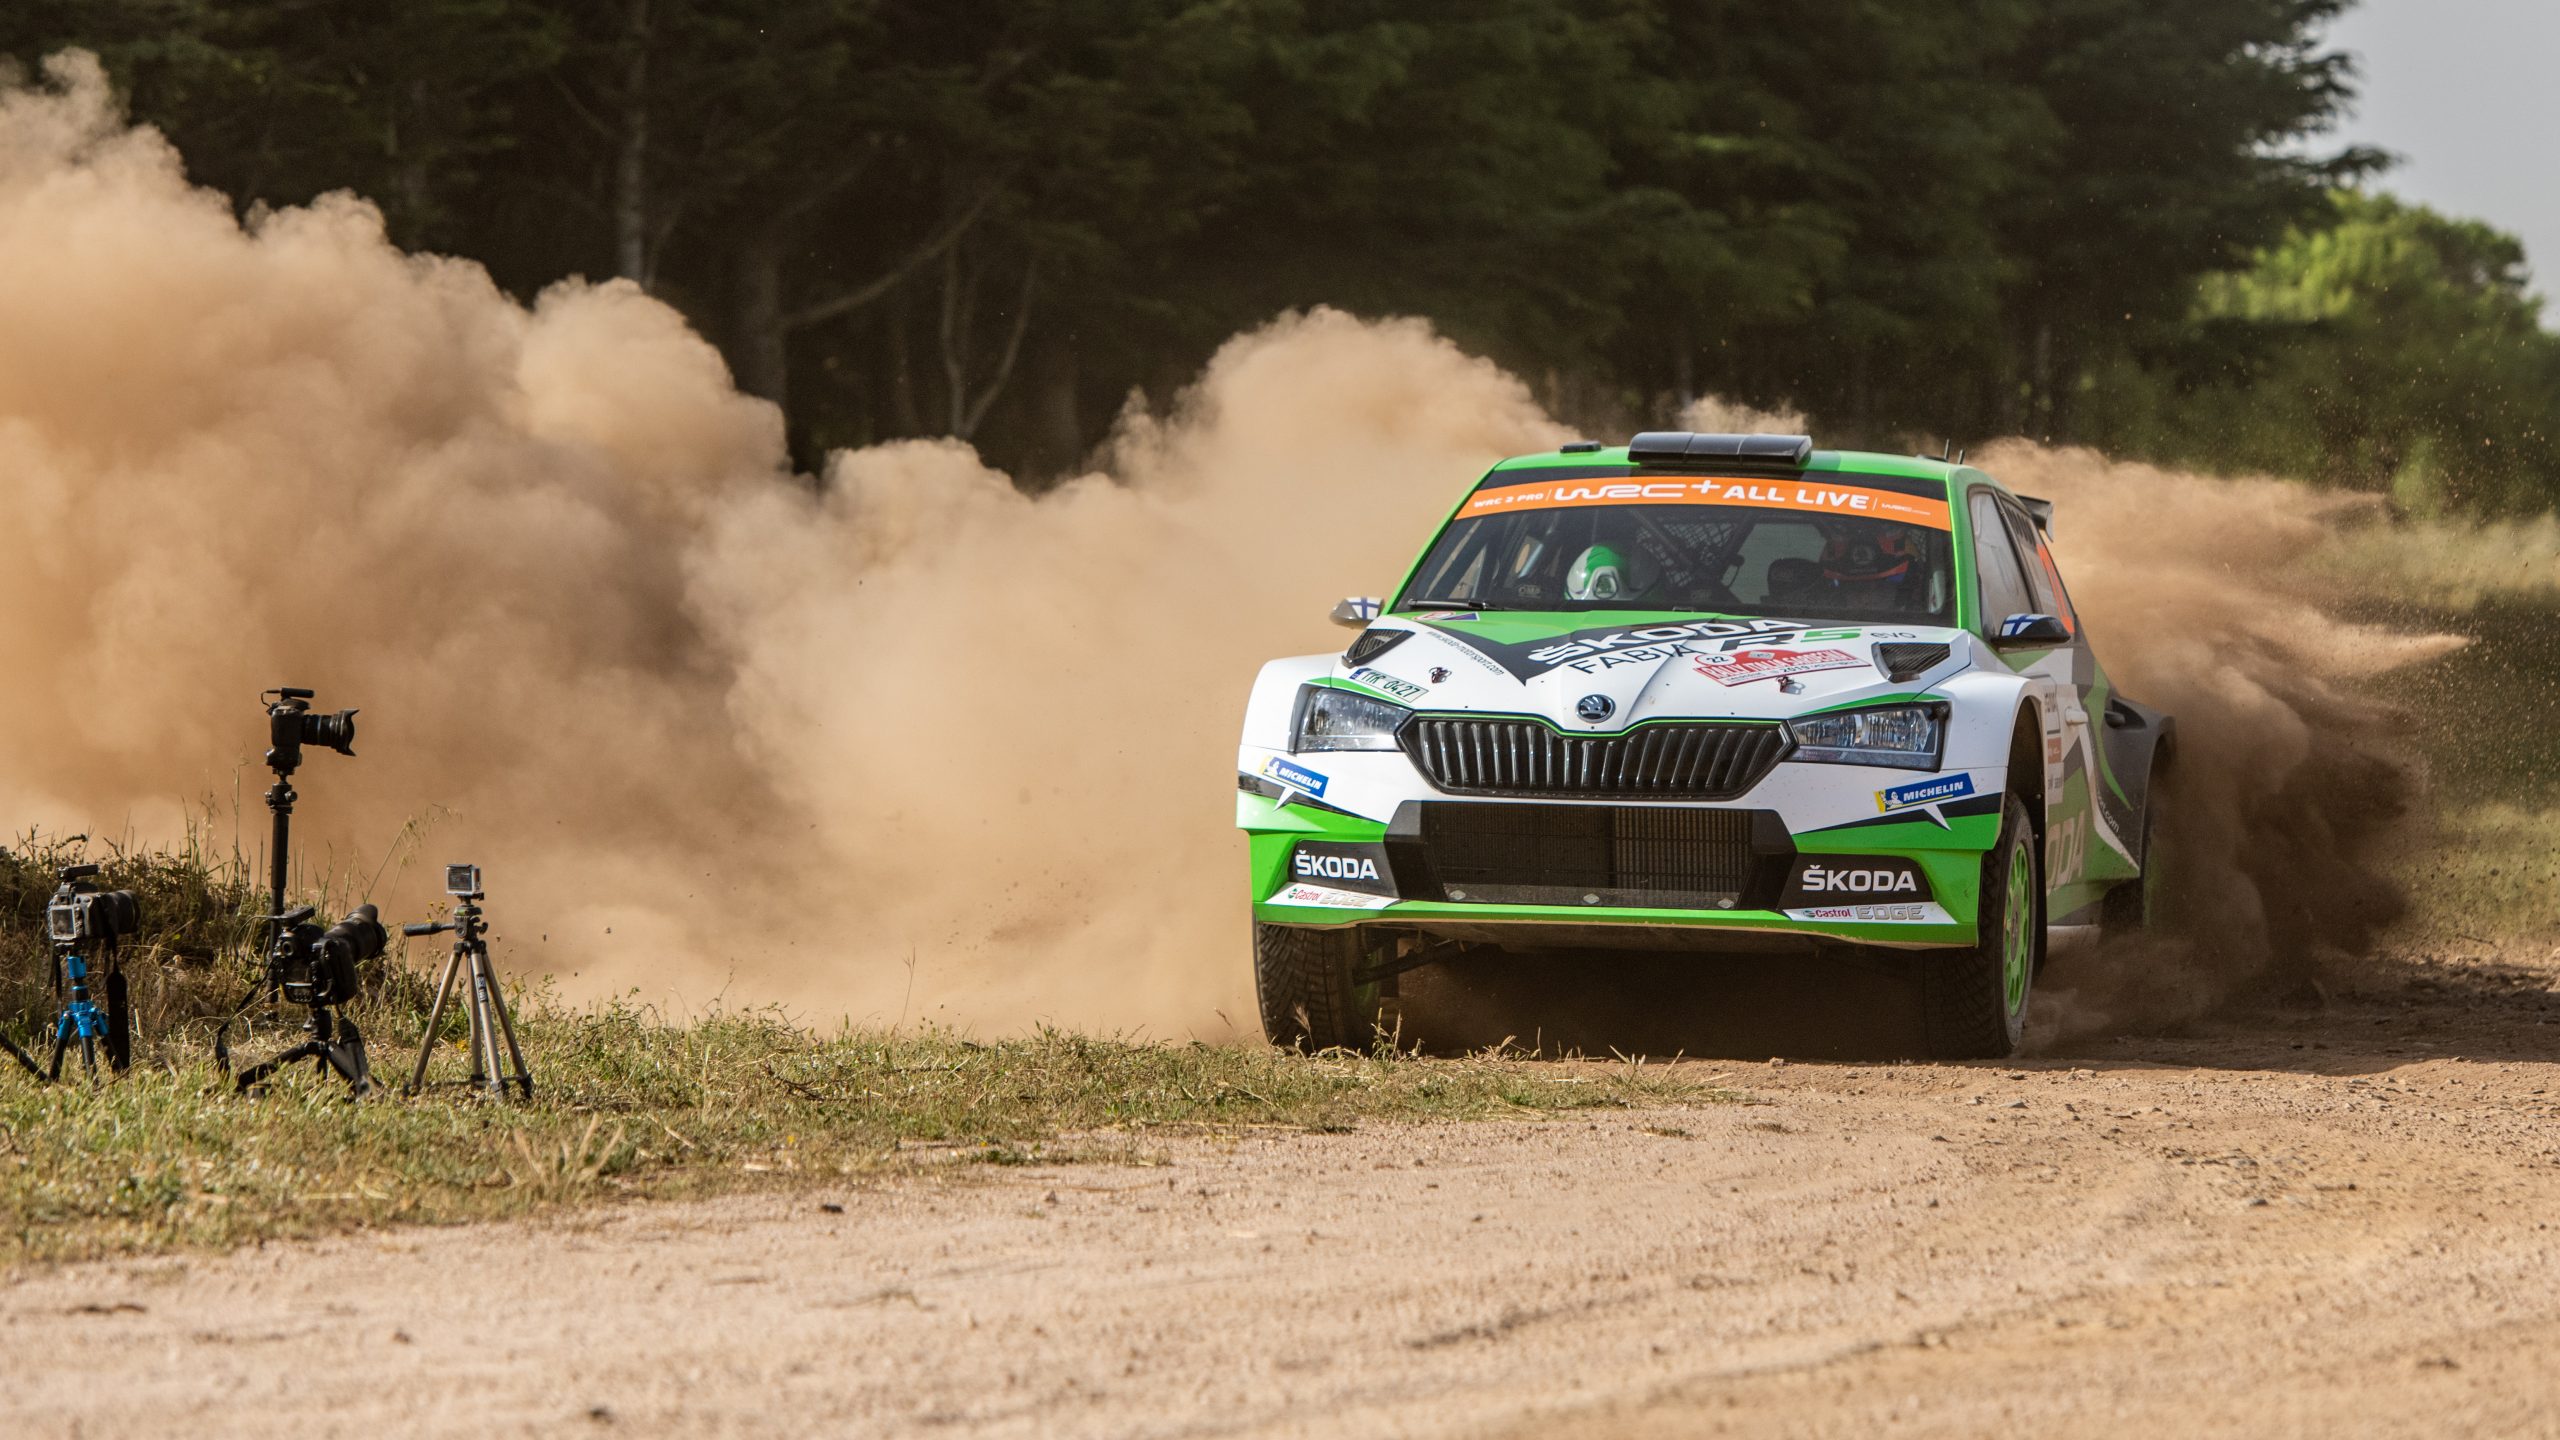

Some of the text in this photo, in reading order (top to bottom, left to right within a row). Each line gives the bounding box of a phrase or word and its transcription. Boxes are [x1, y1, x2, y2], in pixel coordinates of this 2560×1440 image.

[1474, 497, 1502, 508] WRC
[1517, 492, 1544, 502] PRO
[1723, 485, 1785, 502] ALL
[1796, 489, 1870, 510] LIVE
[1527, 619, 1812, 665] ŠKODA
[1568, 643, 1708, 674] FABIA
[1706, 656, 1729, 664] 22
[1383, 680, 1420, 698] 0427
[1279, 767, 1323, 790] MICHELIN
[1903, 781, 1964, 802] MICHELIN
[1295, 850, 1379, 880] ŠKODA
[1802, 864, 1917, 892] ŠKODA
[1295, 889, 1321, 901] Castrol
[1815, 905, 1926, 920] Castrol EDGE
